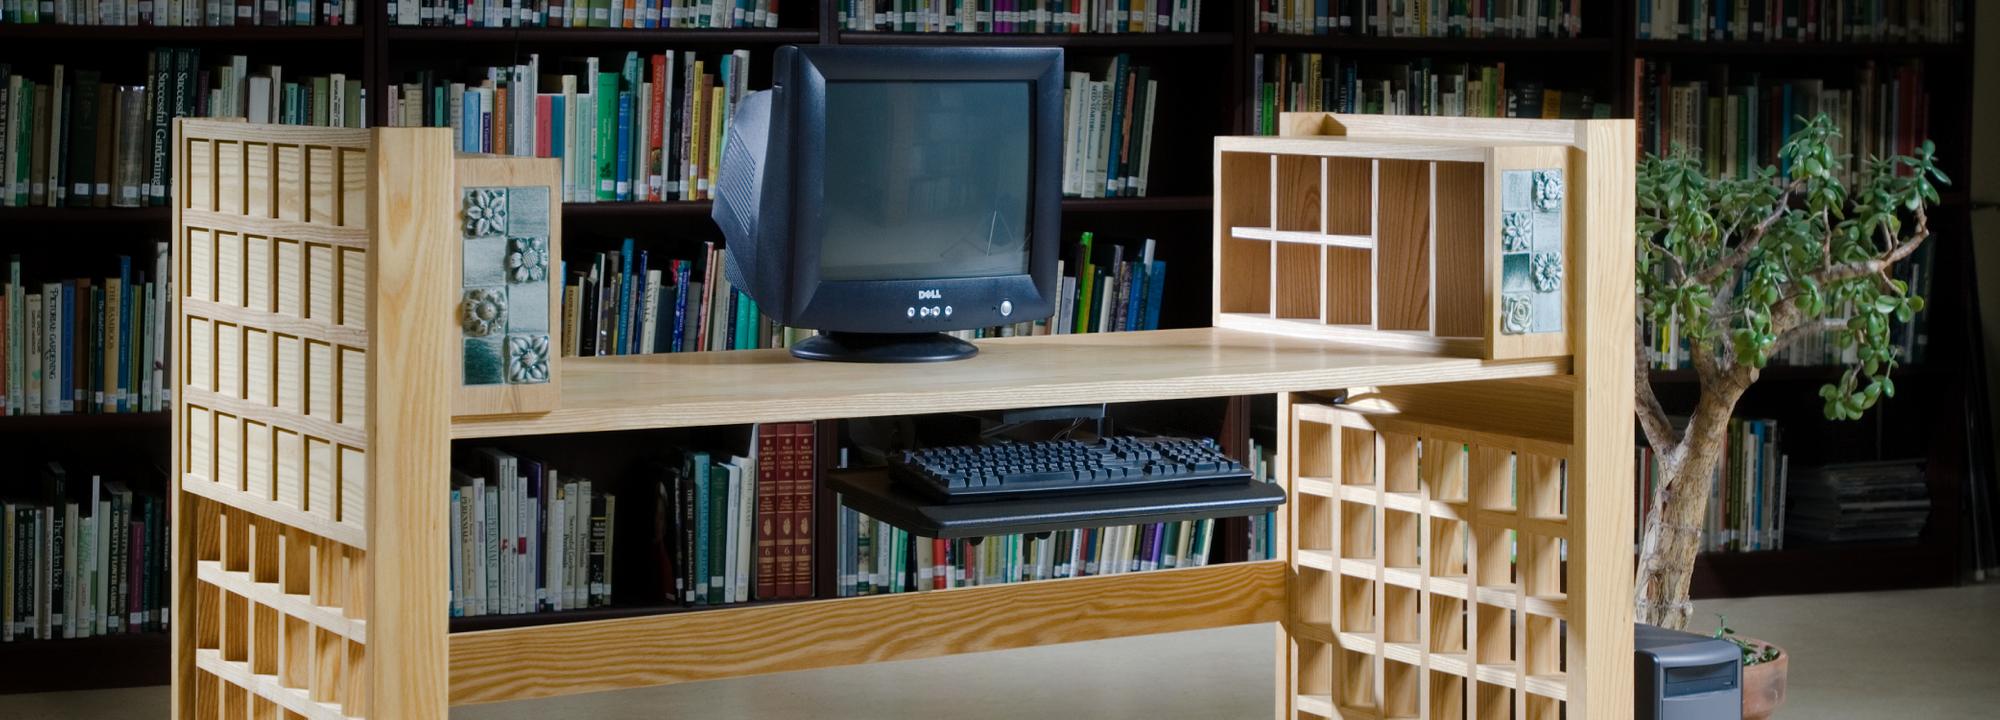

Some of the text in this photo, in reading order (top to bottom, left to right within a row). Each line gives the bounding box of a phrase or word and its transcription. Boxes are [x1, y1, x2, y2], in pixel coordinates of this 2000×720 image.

[156, 72, 170, 127] Successful
[151, 129, 168, 186] Gardening
[918, 289, 942, 300] DELL
[44, 334, 57, 380] GARDENING
[686, 489, 694, 502] THE
[686, 504, 694, 520] TREE
[53, 517, 64, 591] The Garden Book
[488, 517, 498, 569] PERENNIALS
